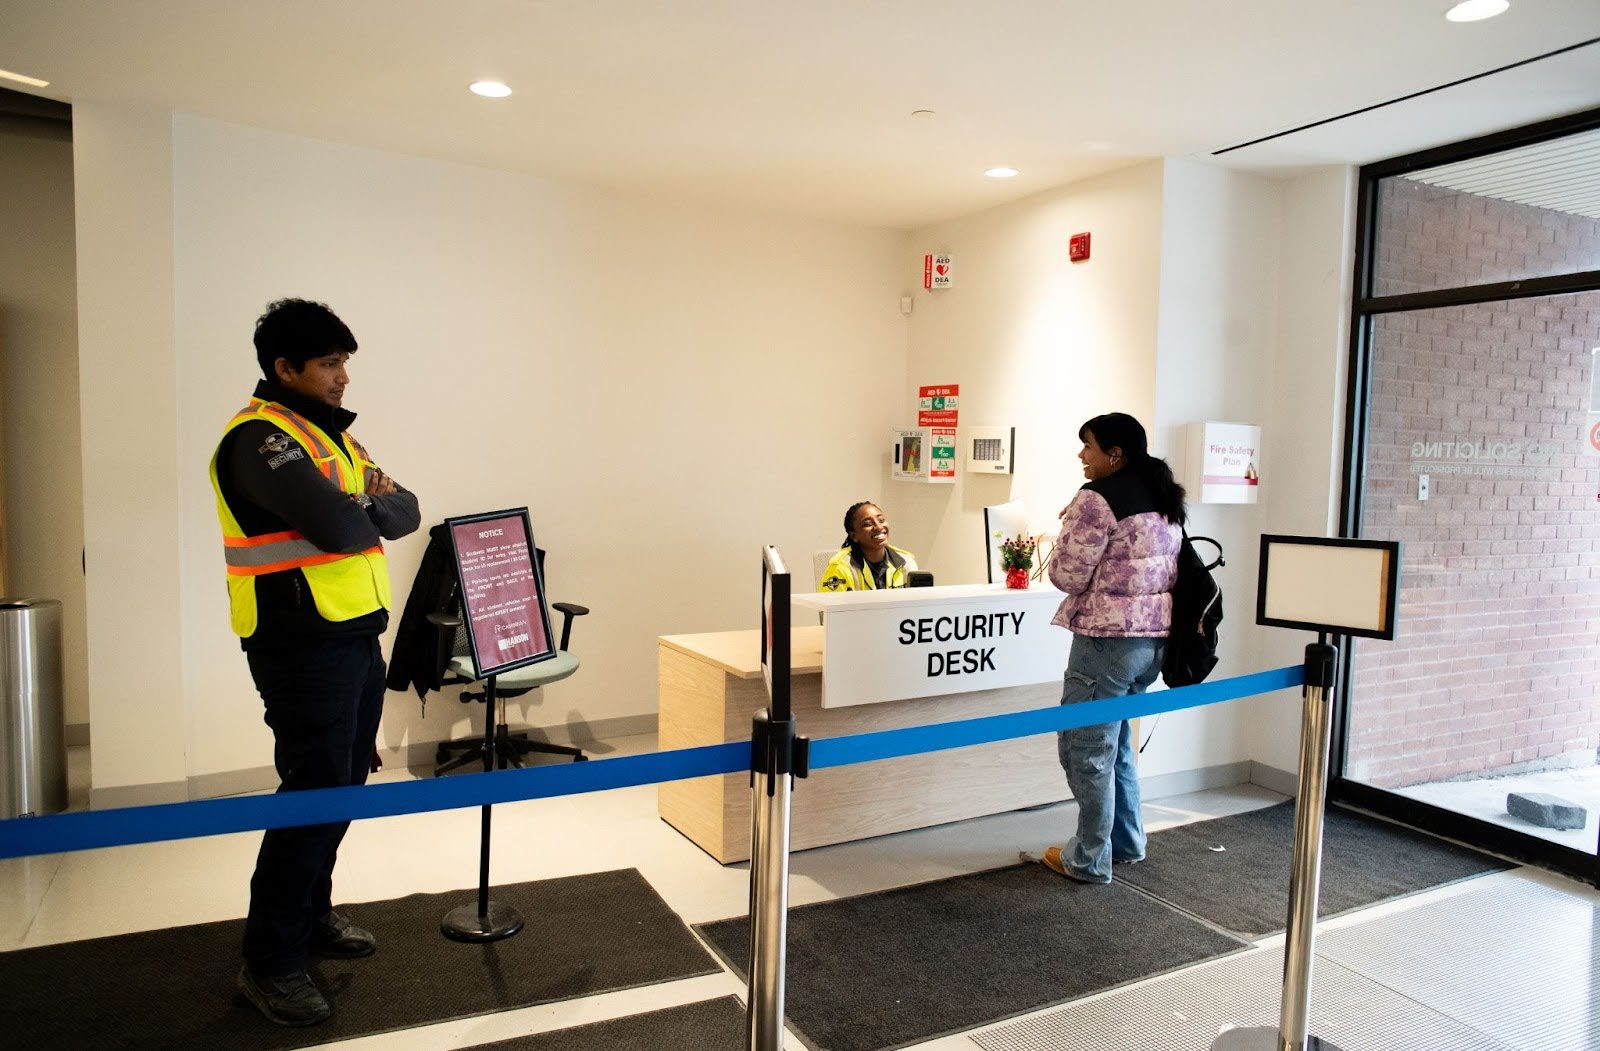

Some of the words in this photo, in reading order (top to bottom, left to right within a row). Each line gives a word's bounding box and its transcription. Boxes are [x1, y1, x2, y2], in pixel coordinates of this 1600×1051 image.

[1210, 445, 1227, 454] Fire
[1229, 446, 1255, 457] Safety
[271, 450, 302, 468] SECURITY
[1223, 457, 1241, 466] Plan
[478, 528, 504, 539] NOTICE
[898, 611, 1026, 645] SECURITY
[505, 633, 529, 646] HANSON
[927, 647, 996, 678] DESK
